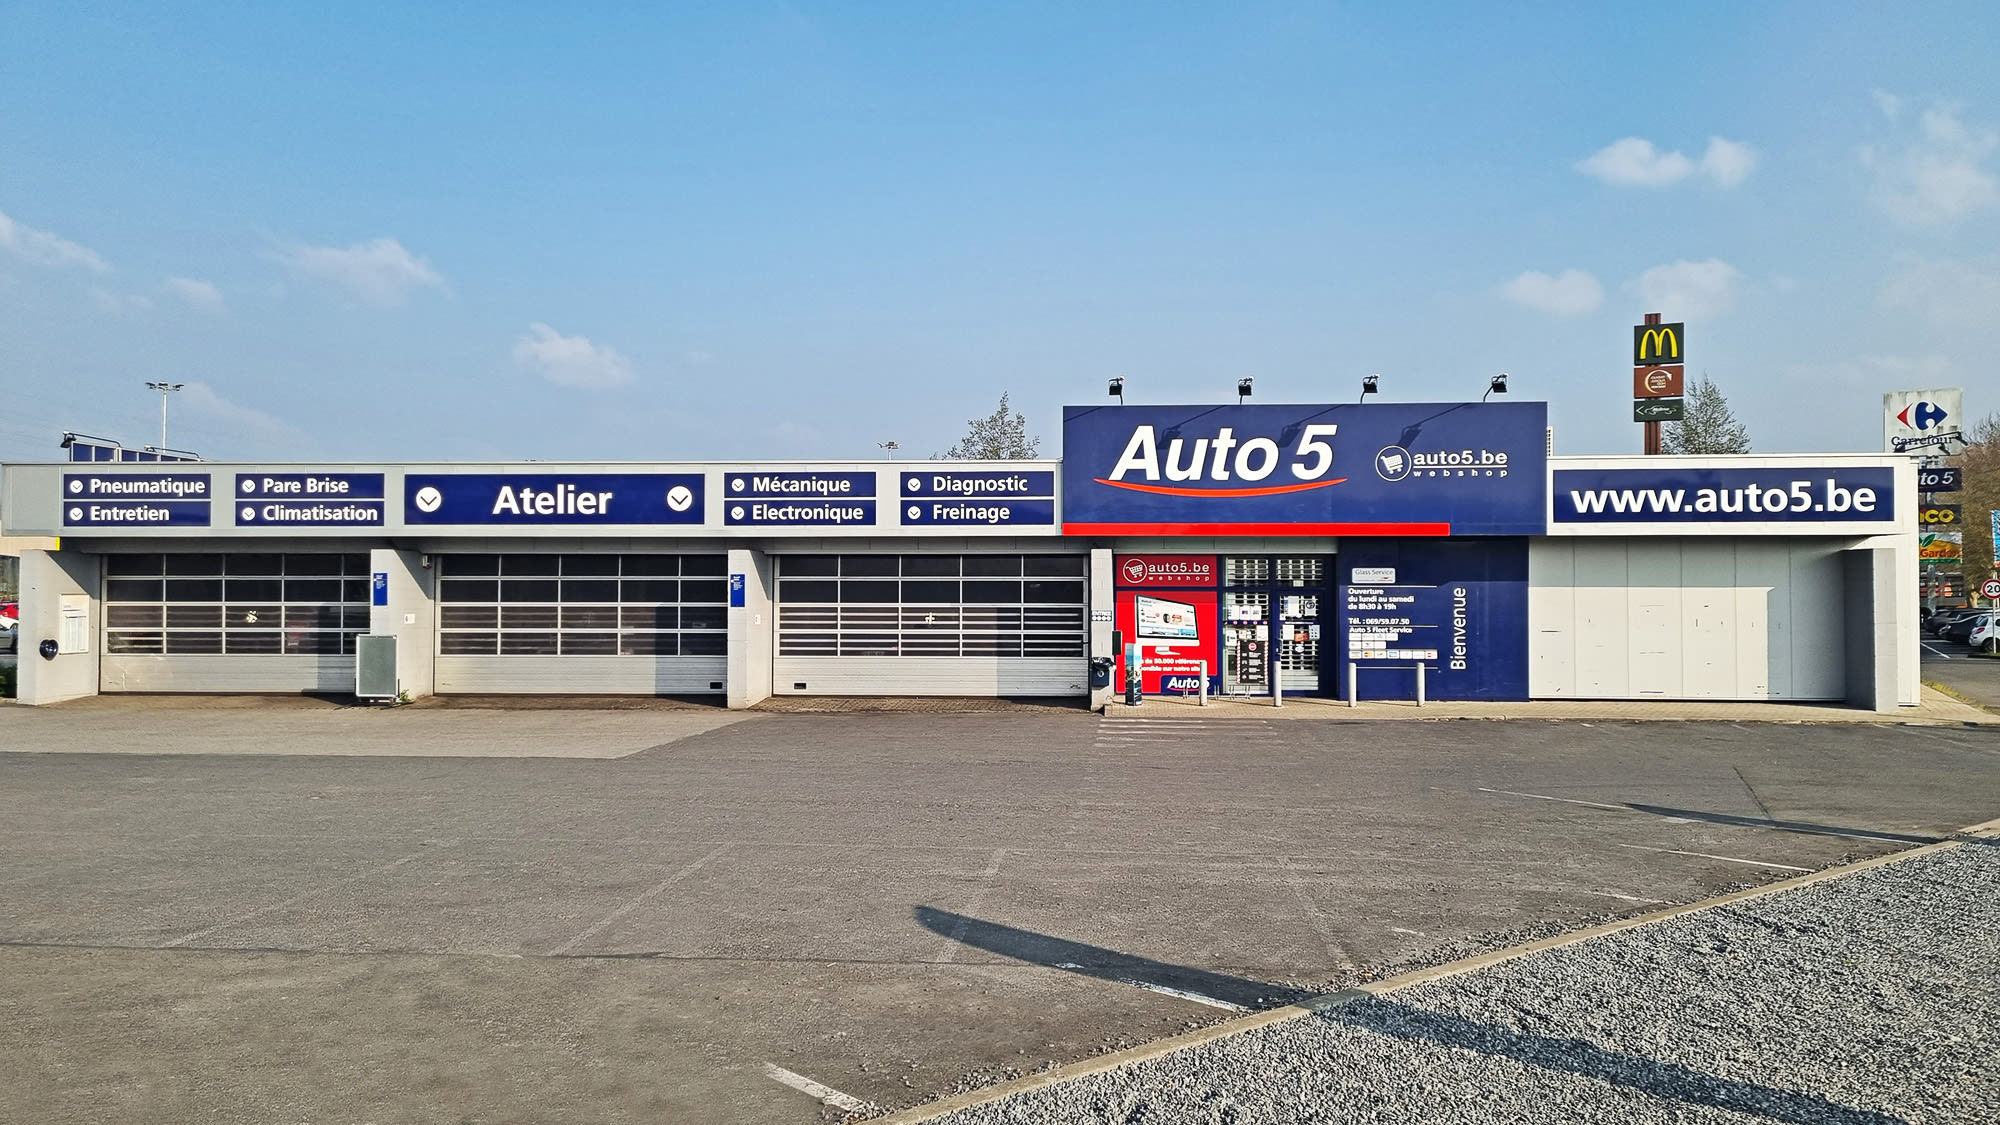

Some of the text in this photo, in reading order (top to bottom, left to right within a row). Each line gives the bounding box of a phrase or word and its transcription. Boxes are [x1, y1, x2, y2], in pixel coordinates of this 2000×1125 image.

[1108, 424, 1338, 482] Auto 5
[1413, 450, 1508, 466] auto5.be
[1413, 468, 1508, 478] webshop
[1942, 471, 1955, 485] 5
[89, 477, 206, 497] Pneumatique
[263, 476, 350, 494] Pare Brise
[753, 475, 851, 495] Mécanique
[933, 474, 1028, 495] Diagnostic
[492, 483, 613, 515] Atelier
[1571, 478, 1877, 514] www.auto5.be
[89, 504, 170, 521] Entretien
[263, 504, 378, 521] Climatisation
[752, 503, 864, 524] Electronique
[933, 503, 1011, 524] Freinage
[1148, 562, 1210, 573] auto5.be
[1987, 584, 2000, 593] 20
[1359, 595, 1377, 603] lundi
[1388, 595, 1415, 603] samedi
[1449, 587, 1467, 670] Bienvenue
[1167, 676, 1200, 690] Auto
